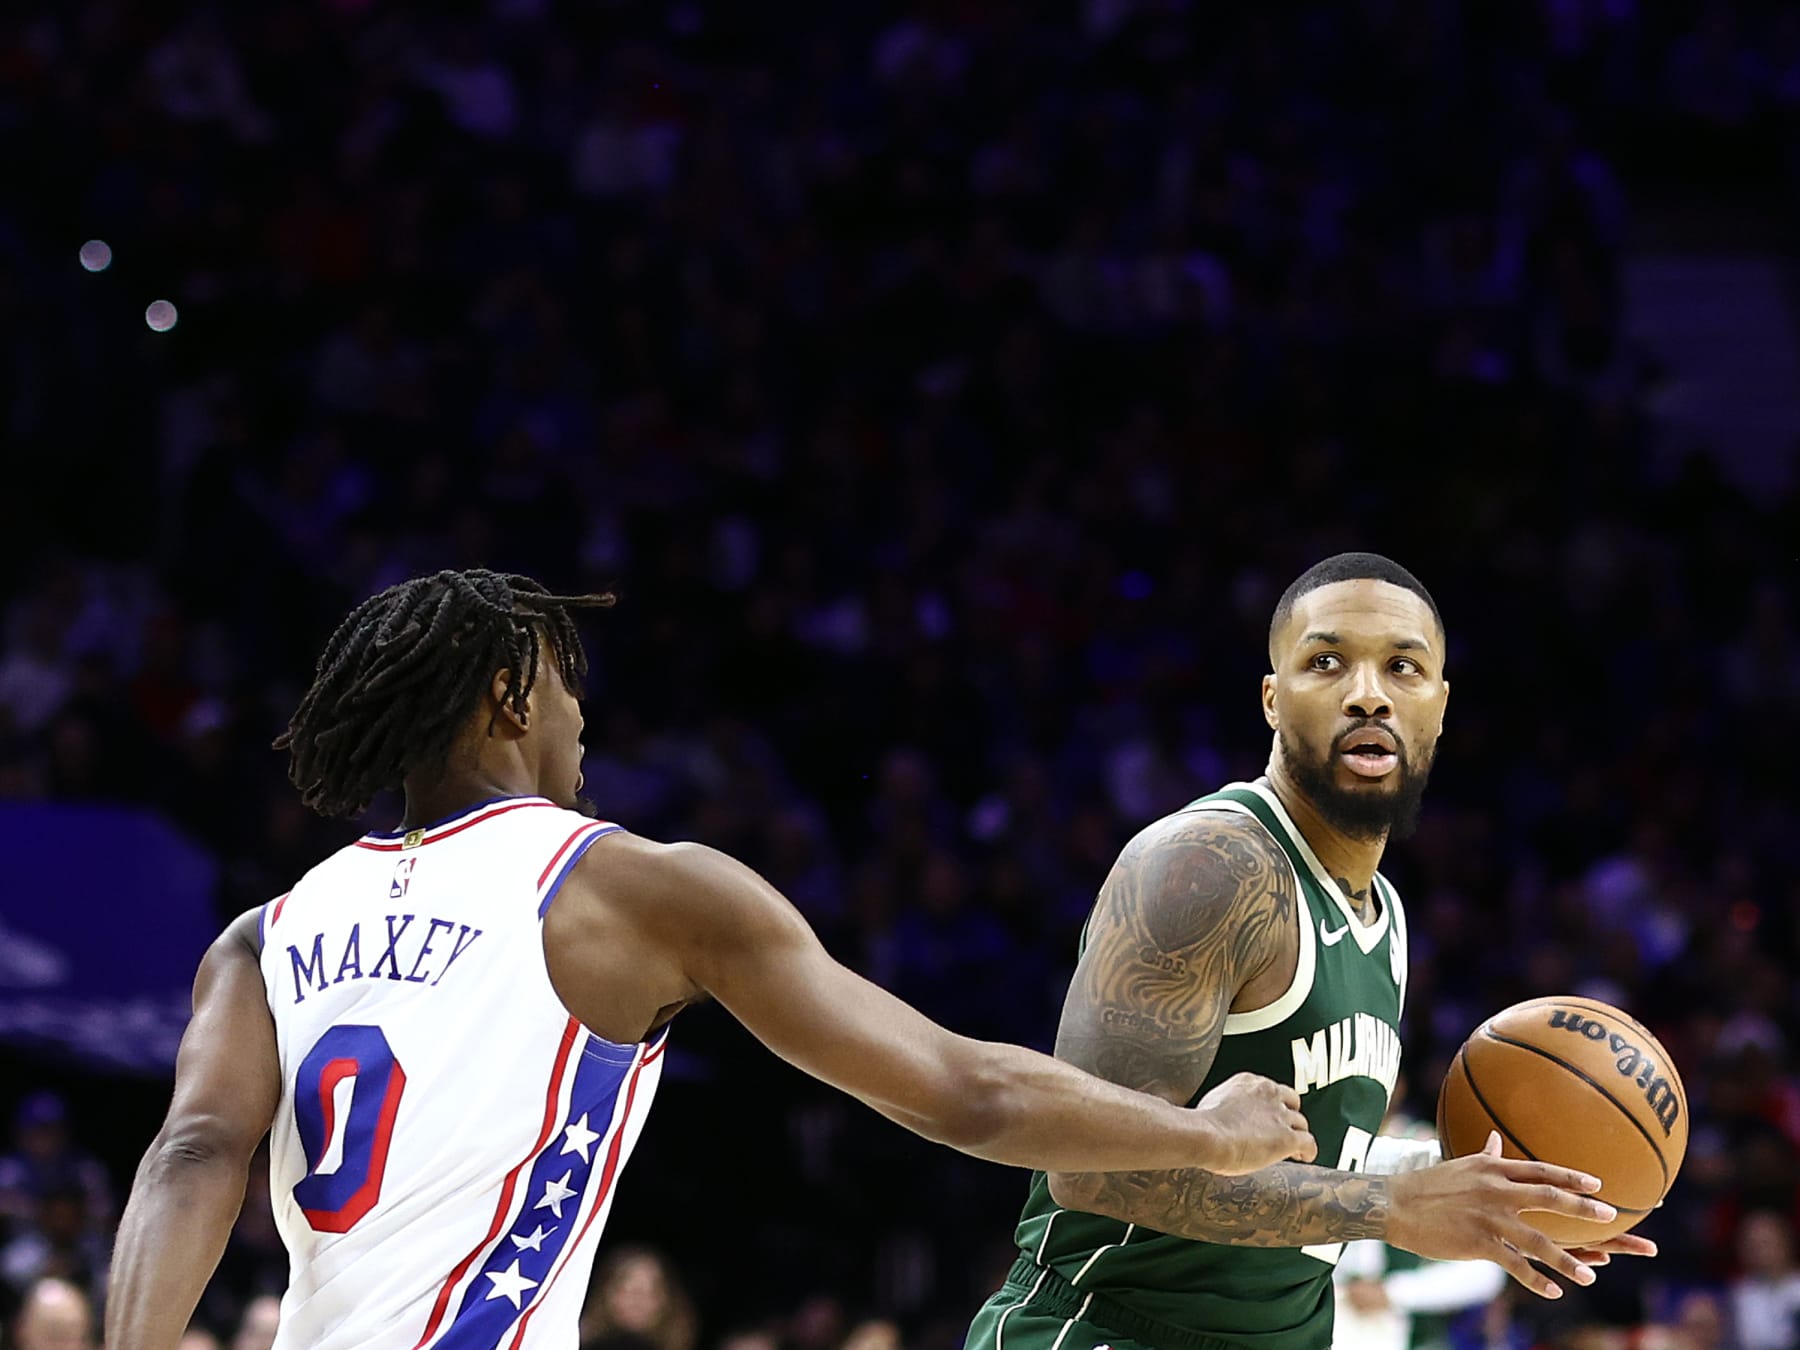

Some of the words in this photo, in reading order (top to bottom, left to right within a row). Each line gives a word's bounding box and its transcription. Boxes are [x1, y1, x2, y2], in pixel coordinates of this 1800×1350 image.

[287, 914, 483, 1005] MAXEY
[293, 1024, 407, 1234] 0
[1548, 1010, 1679, 1138] Wilson
